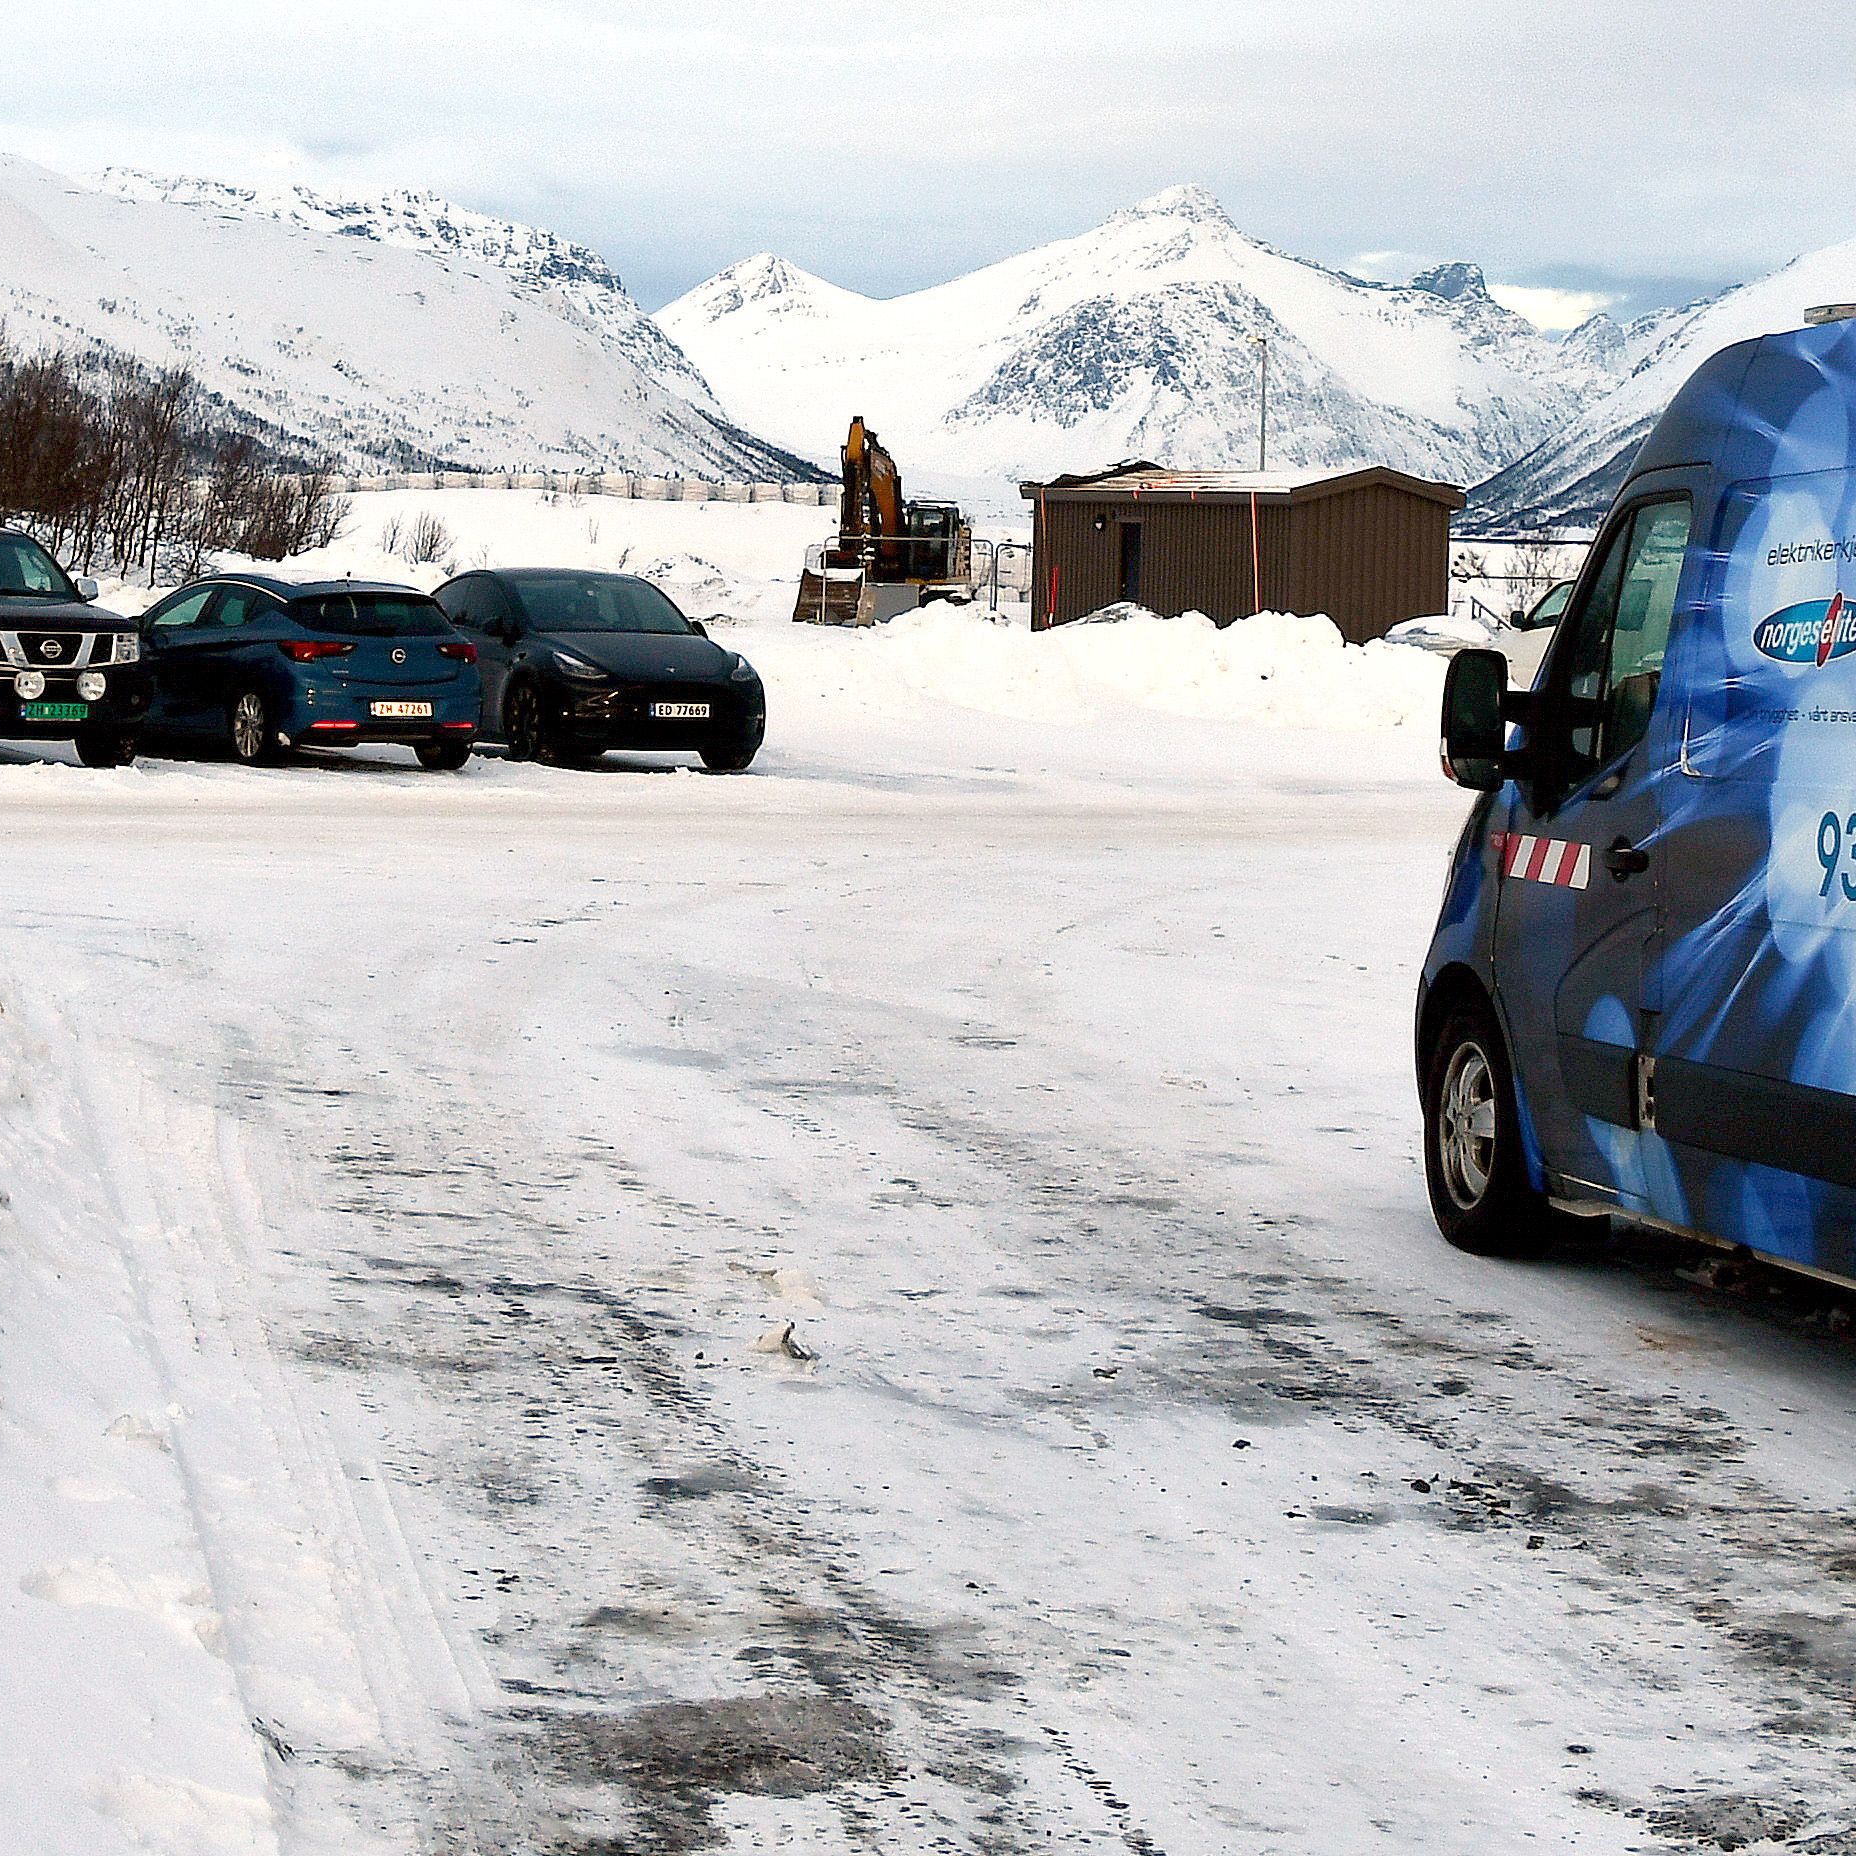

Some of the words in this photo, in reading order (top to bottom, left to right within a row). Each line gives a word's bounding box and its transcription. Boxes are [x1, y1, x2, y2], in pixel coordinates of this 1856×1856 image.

[379, 703, 393, 715] ZH
[397, 703, 429, 715] 47261
[658, 704, 673, 716] ED
[676, 705, 708, 716] 77669
